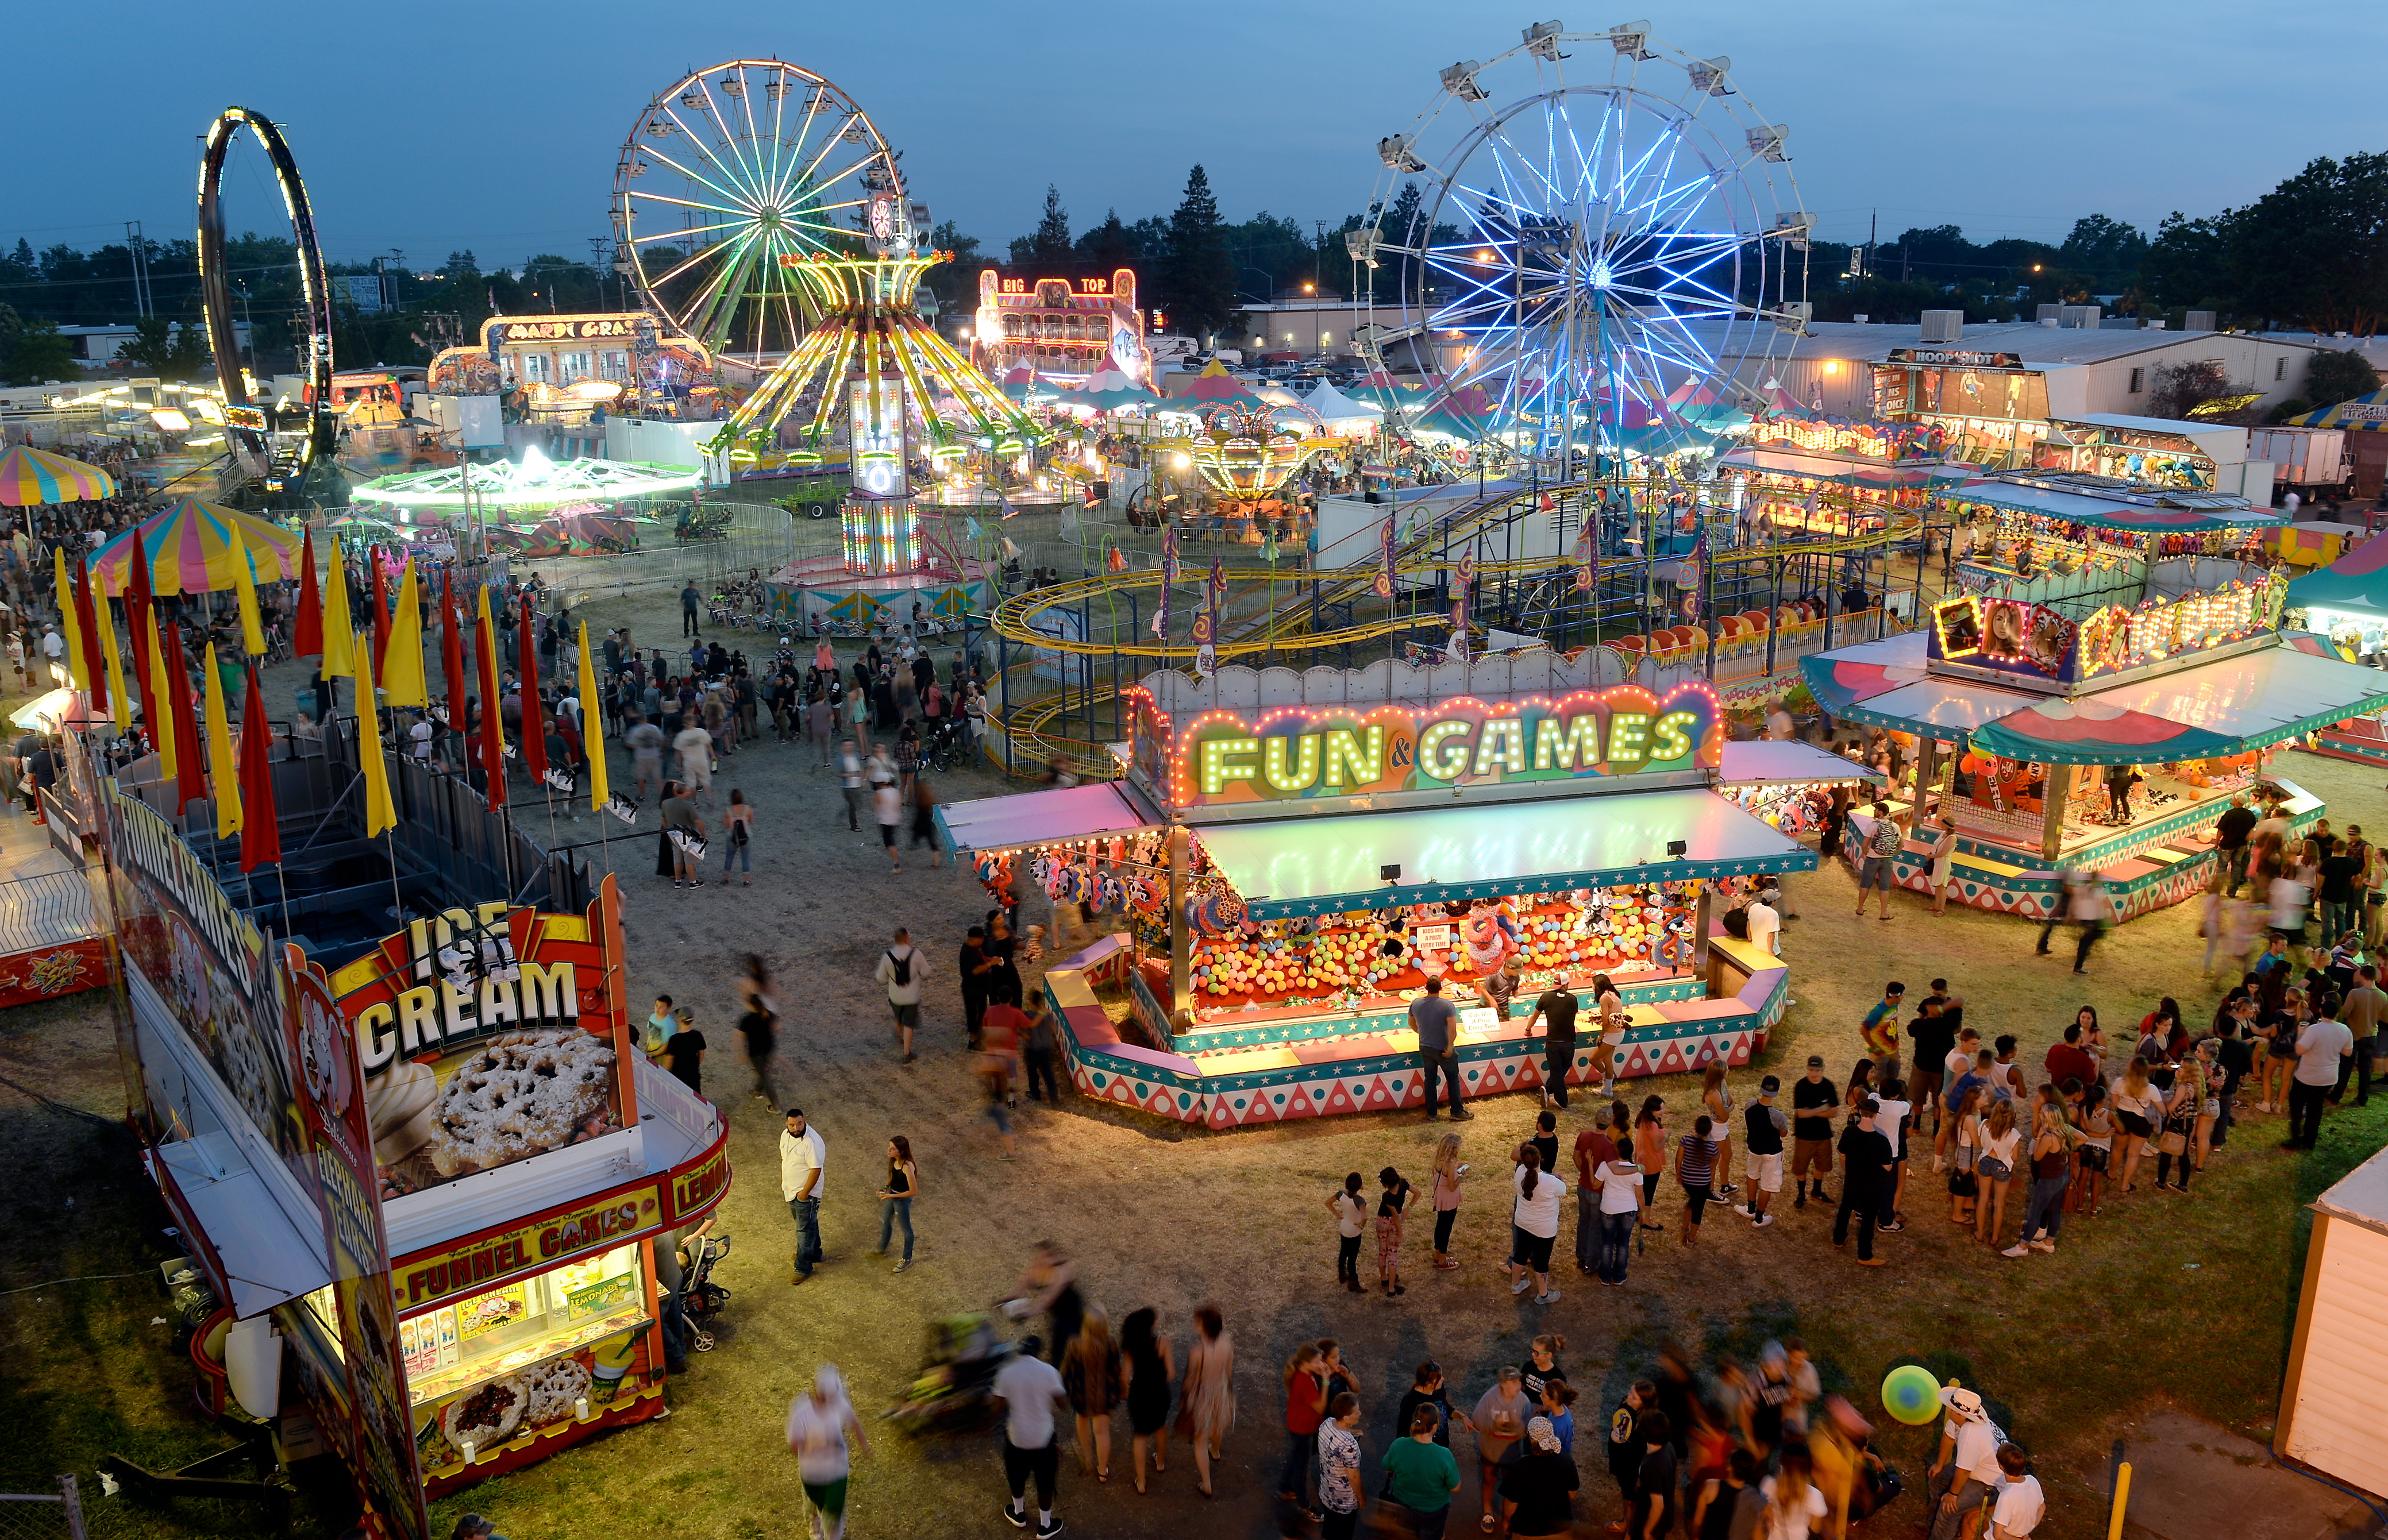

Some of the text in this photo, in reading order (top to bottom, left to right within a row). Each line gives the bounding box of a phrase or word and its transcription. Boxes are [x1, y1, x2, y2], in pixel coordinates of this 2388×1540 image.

[1003, 279, 1107, 292] BIG TOP
[507, 320, 634, 339] MARDI GRAS
[1892, 374, 1900, 382] IN
[1916, 351, 1994, 365] HOOP SHOT
[1983, 421, 2013, 441] SHOT
[2162, 439, 2180, 450] The
[1199, 712, 1698, 795] FUN & GAMES
[118, 794, 253, 1000] FUNNEL CAKES
[409, 900, 513, 980] ICE
[358, 961, 578, 1068] CREAM
[318, 1105, 358, 1168] Delicious
[315, 1141, 378, 1252] ELEPHANT
[333, 1198, 371, 1275] EARS
[408, 1201, 638, 1303] FUNNEL CAKES
[448, 1248, 471, 1260] Fresh
[502, 1231, 521, 1241] With
[533, 1218, 562, 1230] Without
[563, 1206, 596, 1222] Toppings
[461, 1286, 519, 1310] ICE CREAM
[571, 1283, 619, 1306] LEMONADE
